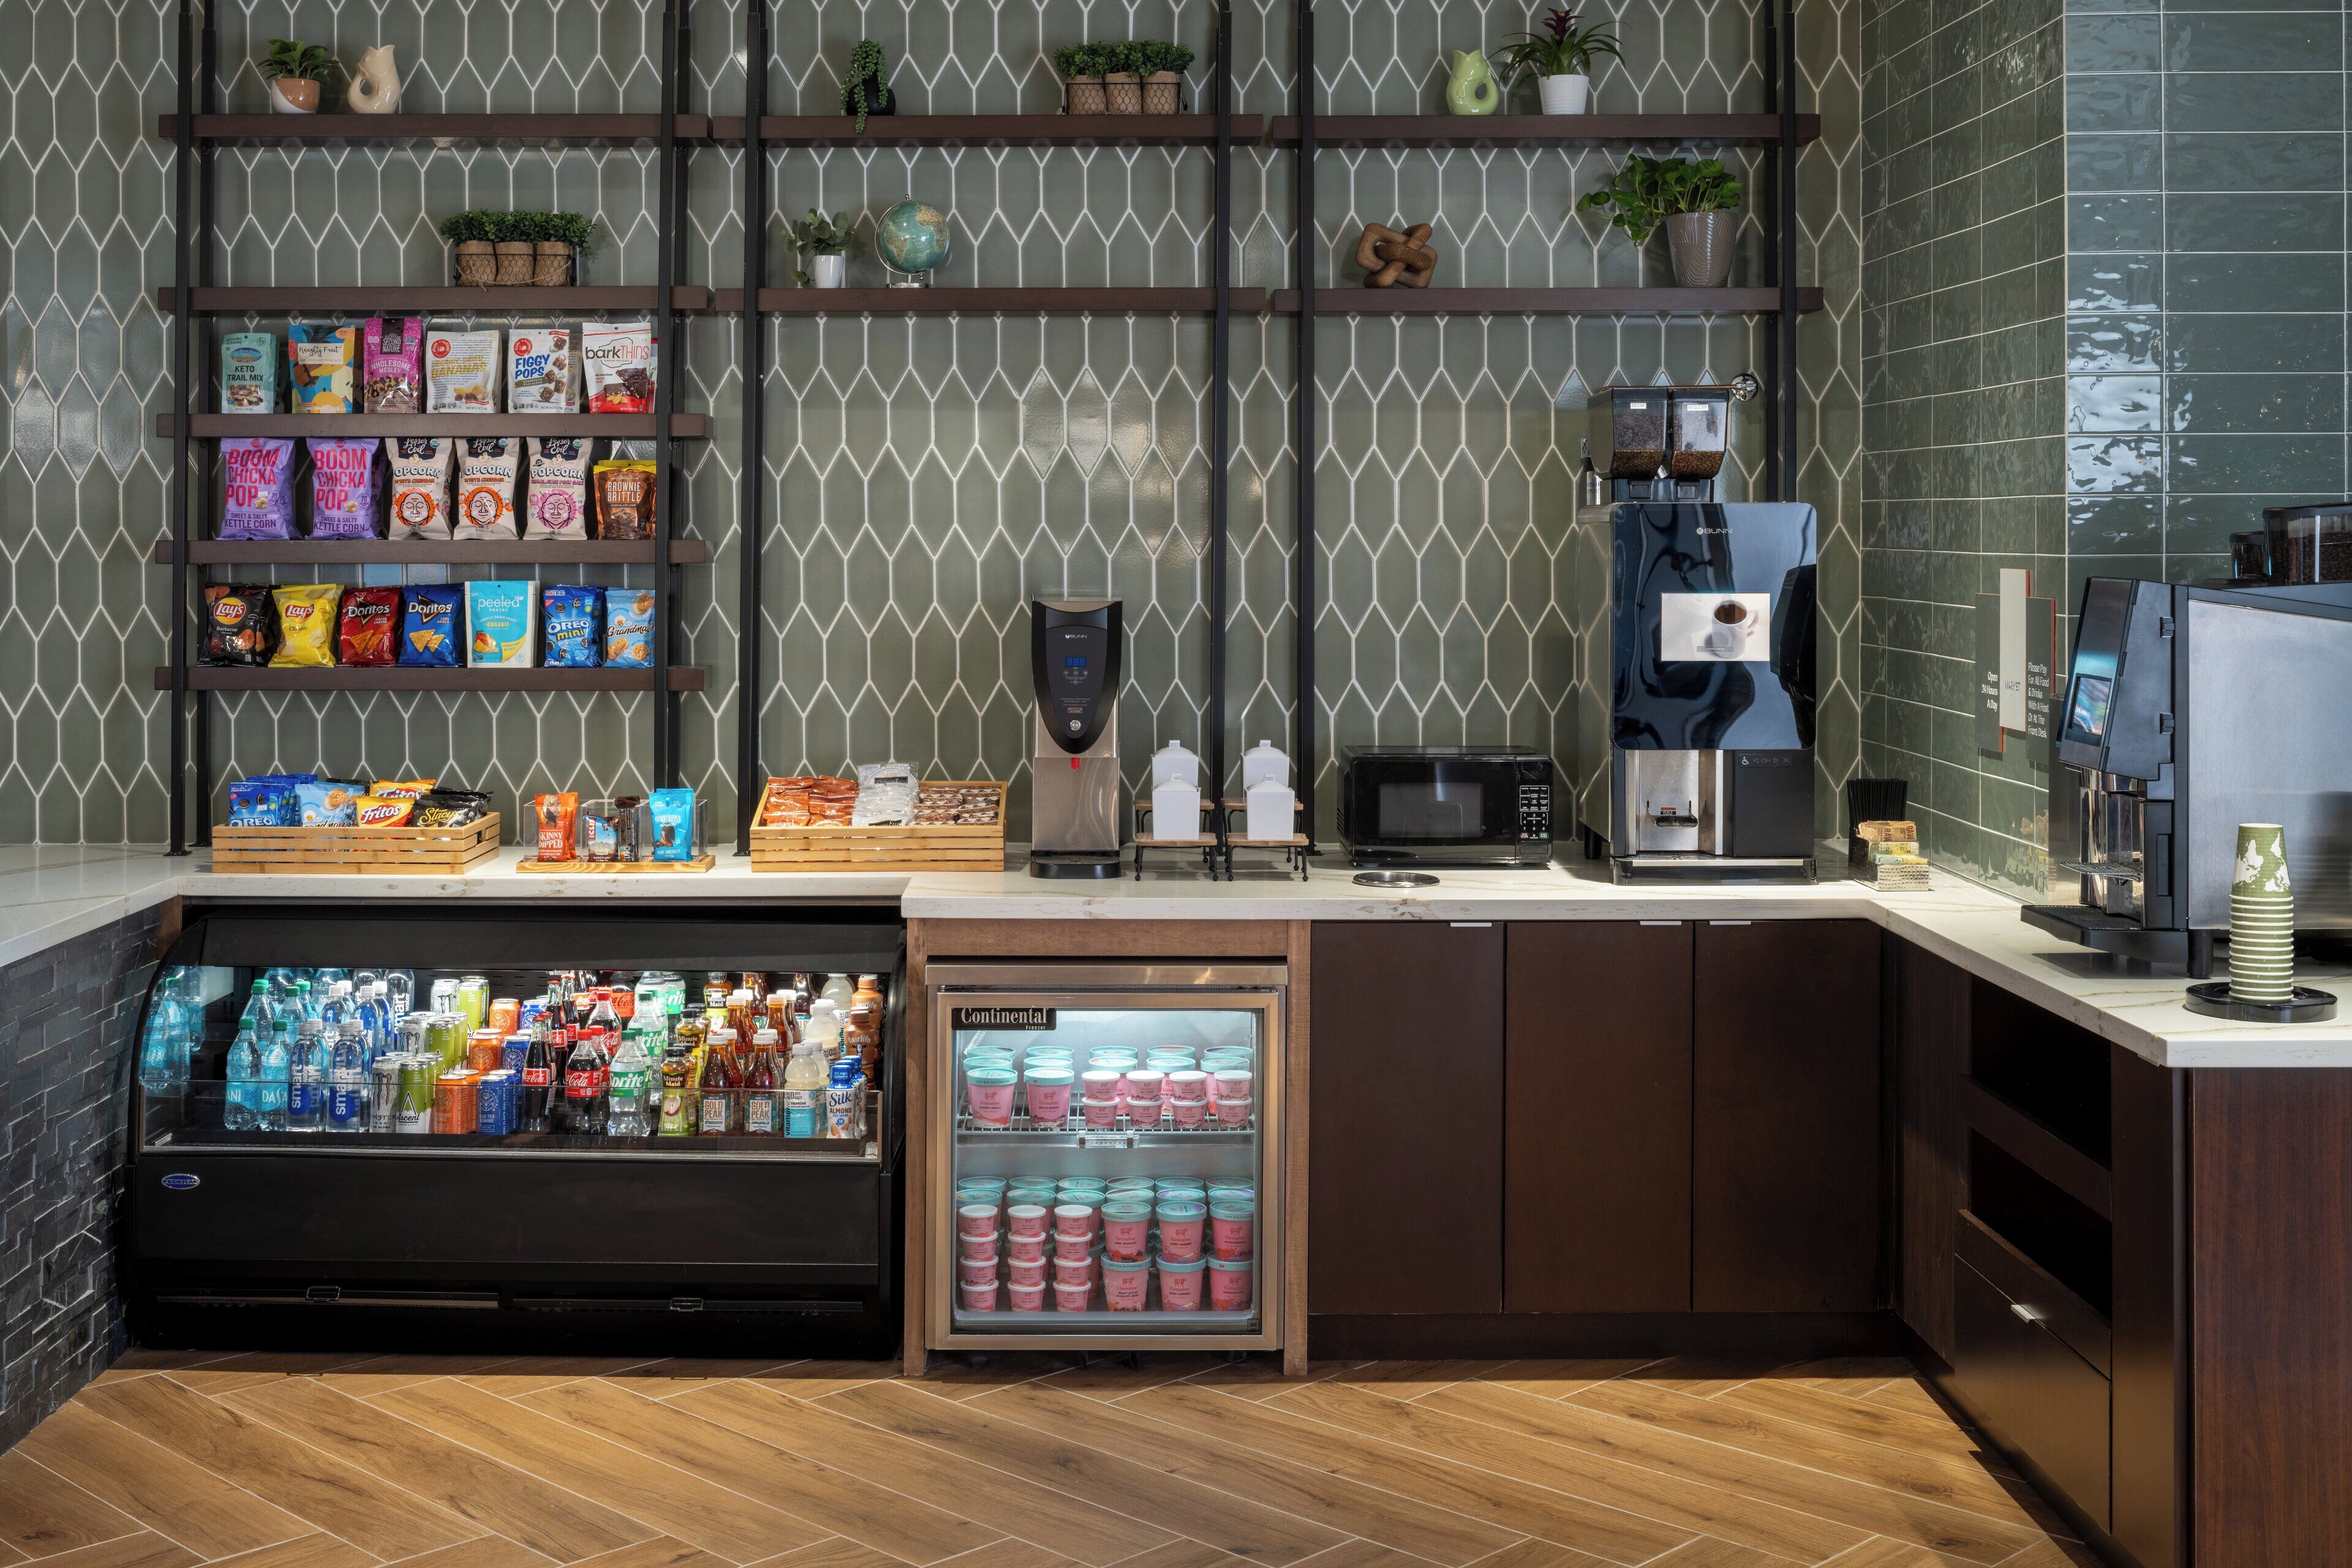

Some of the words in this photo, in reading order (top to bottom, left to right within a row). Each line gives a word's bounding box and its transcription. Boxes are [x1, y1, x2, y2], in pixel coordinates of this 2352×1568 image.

[382, 337, 401, 345] SECOND
[299, 345, 322, 357] Naughty
[586, 345, 649, 360] barkTHINS
[371, 360, 412, 371] WHOLESOME
[515, 353, 550, 369] FIGGY
[515, 366, 544, 379] POPS
[407, 443, 424, 454] Evil
[478, 442, 494, 453] Evil
[551, 443, 567, 454] Evil
[228, 448, 281, 468] BOOM
[314, 448, 367, 470] BOOM
[228, 467, 276, 484] CHICKA
[393, 466, 442, 478] OPCORN
[461, 465, 513, 478] POPCORN
[530, 467, 584, 480] POPCORN
[317, 471, 366, 488] CHICKA
[608, 481, 641, 492] BROWNIE
[226, 484, 258, 507] POP
[315, 488, 349, 511] POP
[607, 492, 640, 502] BRITTLE
[224, 519, 252, 528] KETTLE
[254, 519, 276, 529] CORN
[314, 521, 341, 532] KETTLE
[343, 524, 364, 533] CORN
[409, 601, 453, 613] Doritos
[478, 595, 520, 611] peeled
[216, 603, 244, 619] Lay's
[285, 605, 314, 619] Lay's
[347, 605, 390, 618] Doritos
[548, 620, 589, 634] OREO
[557, 628, 584, 641] mini
[2028, 662, 2040, 673] Please
[1988, 671, 1997, 683] Open
[2040, 677, 2049, 687] Food
[1981, 684, 1986, 693] 24
[1986, 685, 1998, 696] Hours
[2028, 687, 2031, 696] &
[2032, 688, 2043, 698] Drinks
[1987, 699, 1990, 708] A
[2028, 700, 2037, 710] With
[2037, 702, 2040, 711] A
[2040, 703, 2049, 713] Host
[2028, 712, 2034, 722] Or
[2034, 714, 2038, 723] At
[2028, 725, 2038, 736] Front
[2038, 728, 2047, 738] Desk
[361, 804, 401, 823] Fritos
[419, 807, 460, 825] Stacy's
[228, 818, 272, 827] OREO
[539, 832, 563, 841] SKINNY
[539, 839, 563, 848] DIPPED
[961, 1007, 1048, 1023] Continental
[292, 1065, 302, 1109] smart
[336, 1068, 346, 1115] smart
[829, 1091, 853, 1107] Silk
[705, 1101, 723, 1110] GOLD
[752, 1101, 769, 1110] GOLD
[705, 1110, 723, 1118] PEAK
[752, 1110, 769, 1118] PEAK
